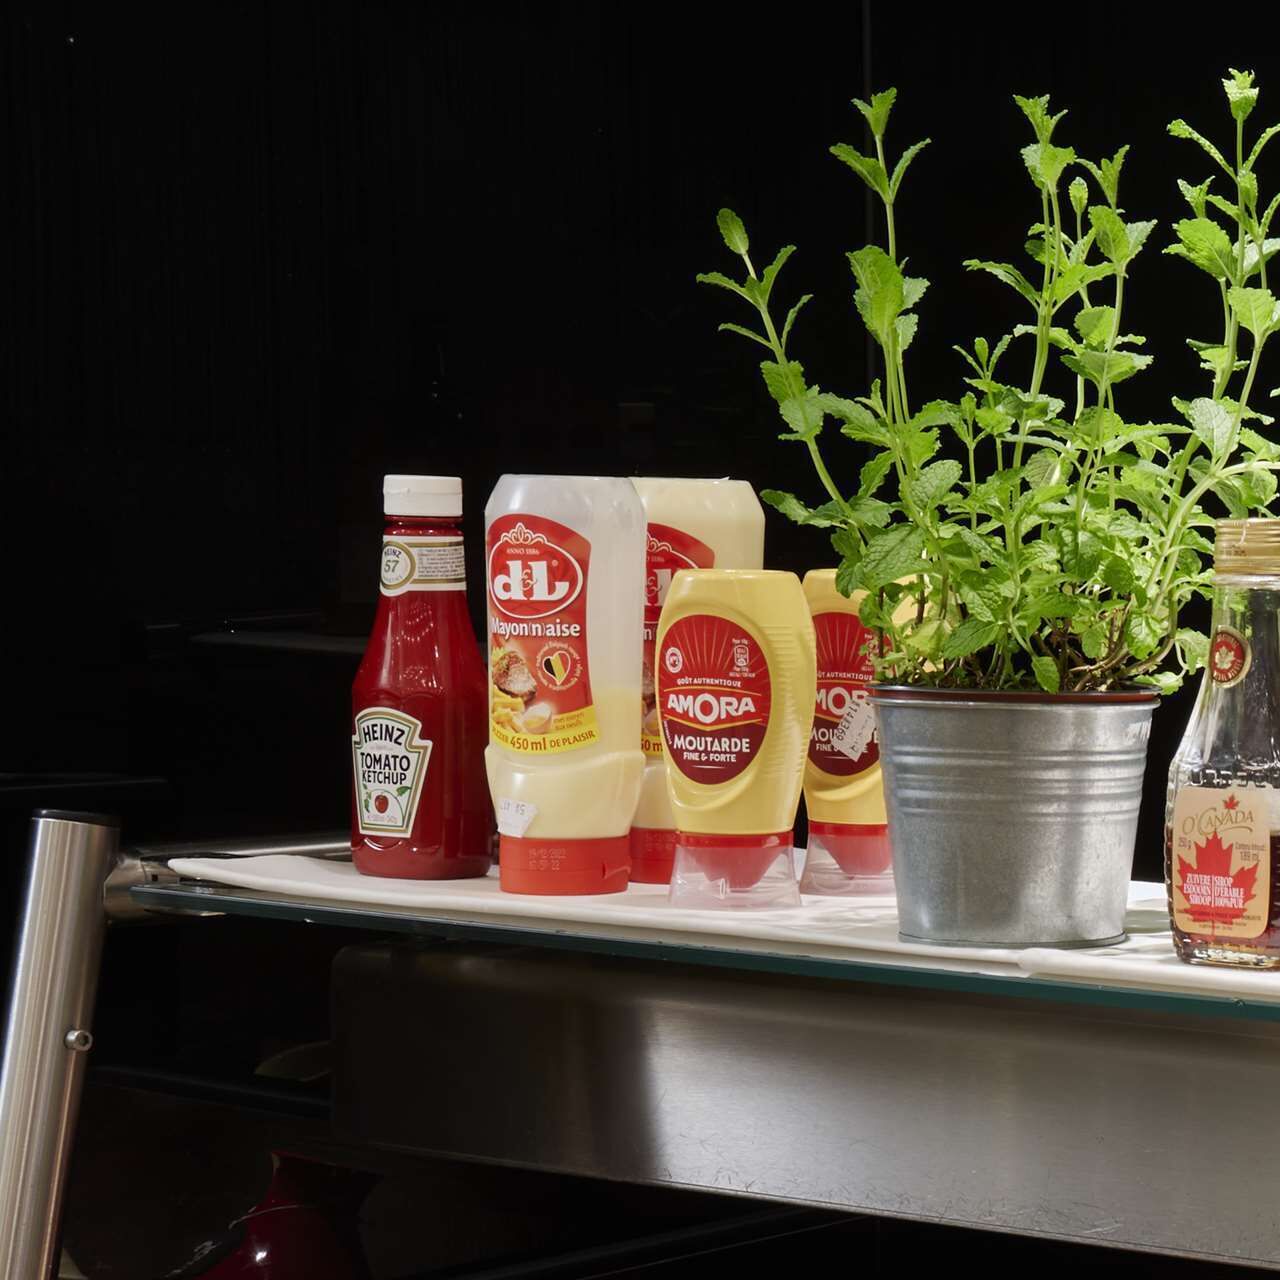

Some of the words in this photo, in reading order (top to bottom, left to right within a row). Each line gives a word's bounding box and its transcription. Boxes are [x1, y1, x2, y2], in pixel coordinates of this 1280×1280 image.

[384, 560, 400, 573] 57
[492, 618, 581, 640] Mayon(n)aise
[677, 677, 692, 685] GOÛT
[694, 678, 741, 687] AUTHENTIQUE
[668, 693, 756, 724] AMORA
[363, 724, 405, 746] HEINZ
[510, 736, 528, 751] 450
[530, 737, 546, 752] ml
[550, 738, 560, 748] DE
[562, 730, 596, 746] PLAISIR
[674, 734, 750, 752] MOUTARDE
[816, 743, 832, 752] FINE
[360, 752, 410, 772] TOMATO
[684, 752, 700, 760] FINE
[710, 754, 736, 762] FORTE
[362, 770, 406, 785] KETCHUP
[1186, 874, 1212, 885] ZUIVERE
[1214, 876, 1233, 888] SIROP
[1189, 894, 1212, 906] SIROOP
